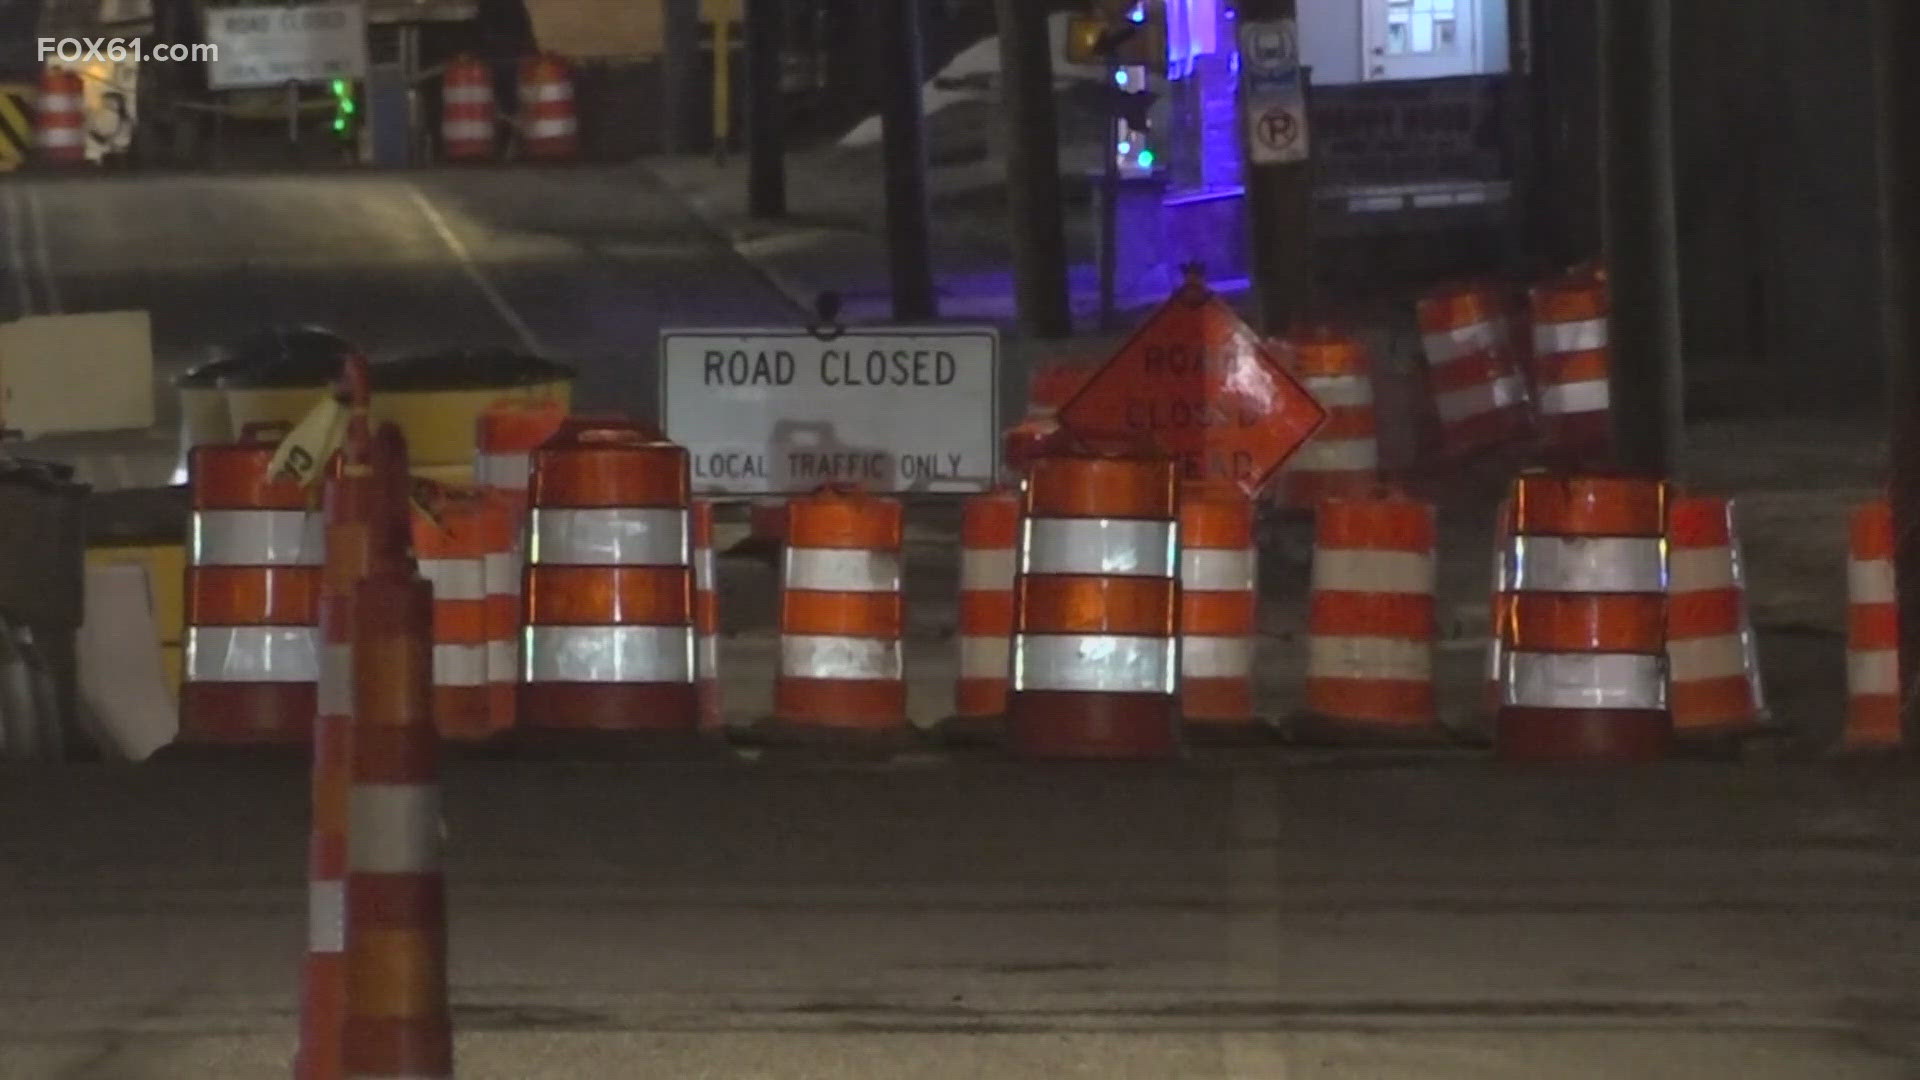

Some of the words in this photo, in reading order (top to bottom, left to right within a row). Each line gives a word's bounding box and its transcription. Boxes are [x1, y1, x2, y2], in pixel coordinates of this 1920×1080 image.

[704, 350, 795, 385] ROAD
[820, 350, 956, 386] CLOSED
[695, 455, 768, 478] LOCAL
[788, 454, 885, 478] TRAFFIC
[901, 455, 962, 479] ONLY
